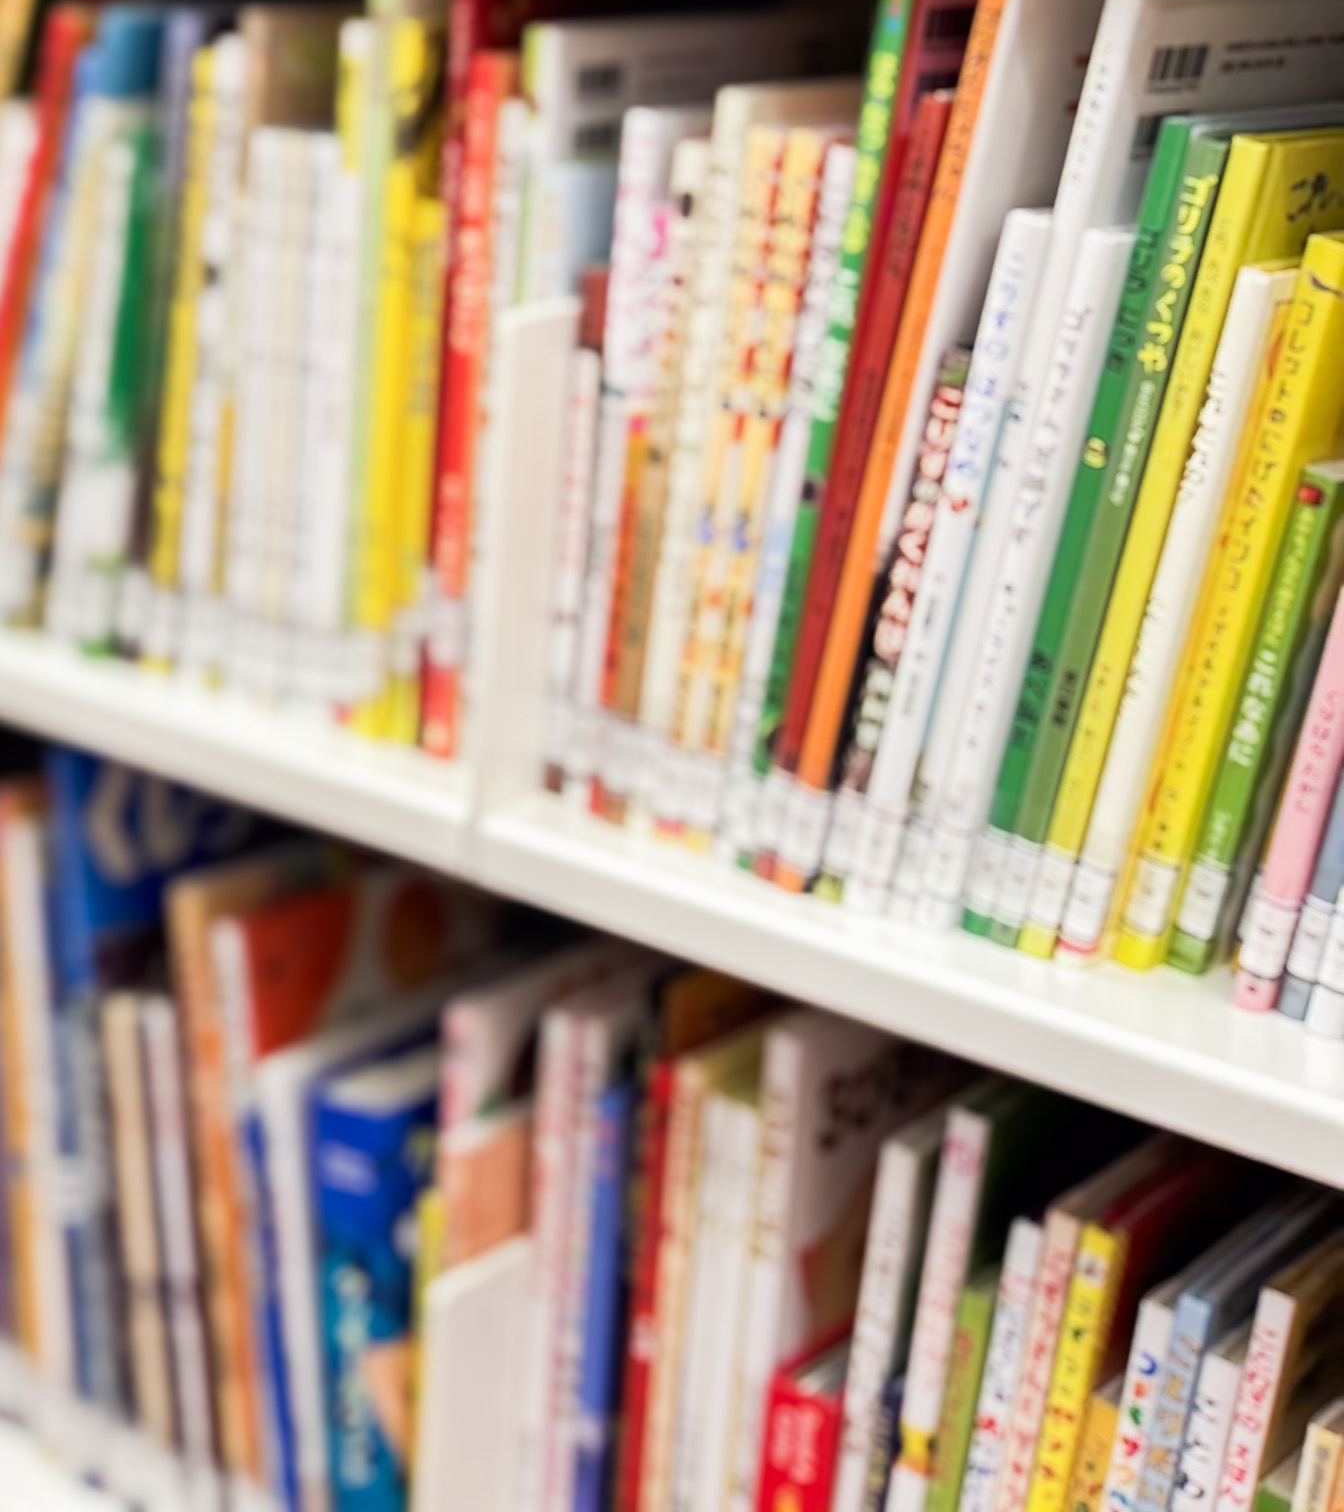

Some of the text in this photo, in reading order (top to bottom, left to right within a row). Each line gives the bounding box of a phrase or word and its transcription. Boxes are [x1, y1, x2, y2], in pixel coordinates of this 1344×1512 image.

[1138, 173, 1220, 375] ゴリラのくつや
